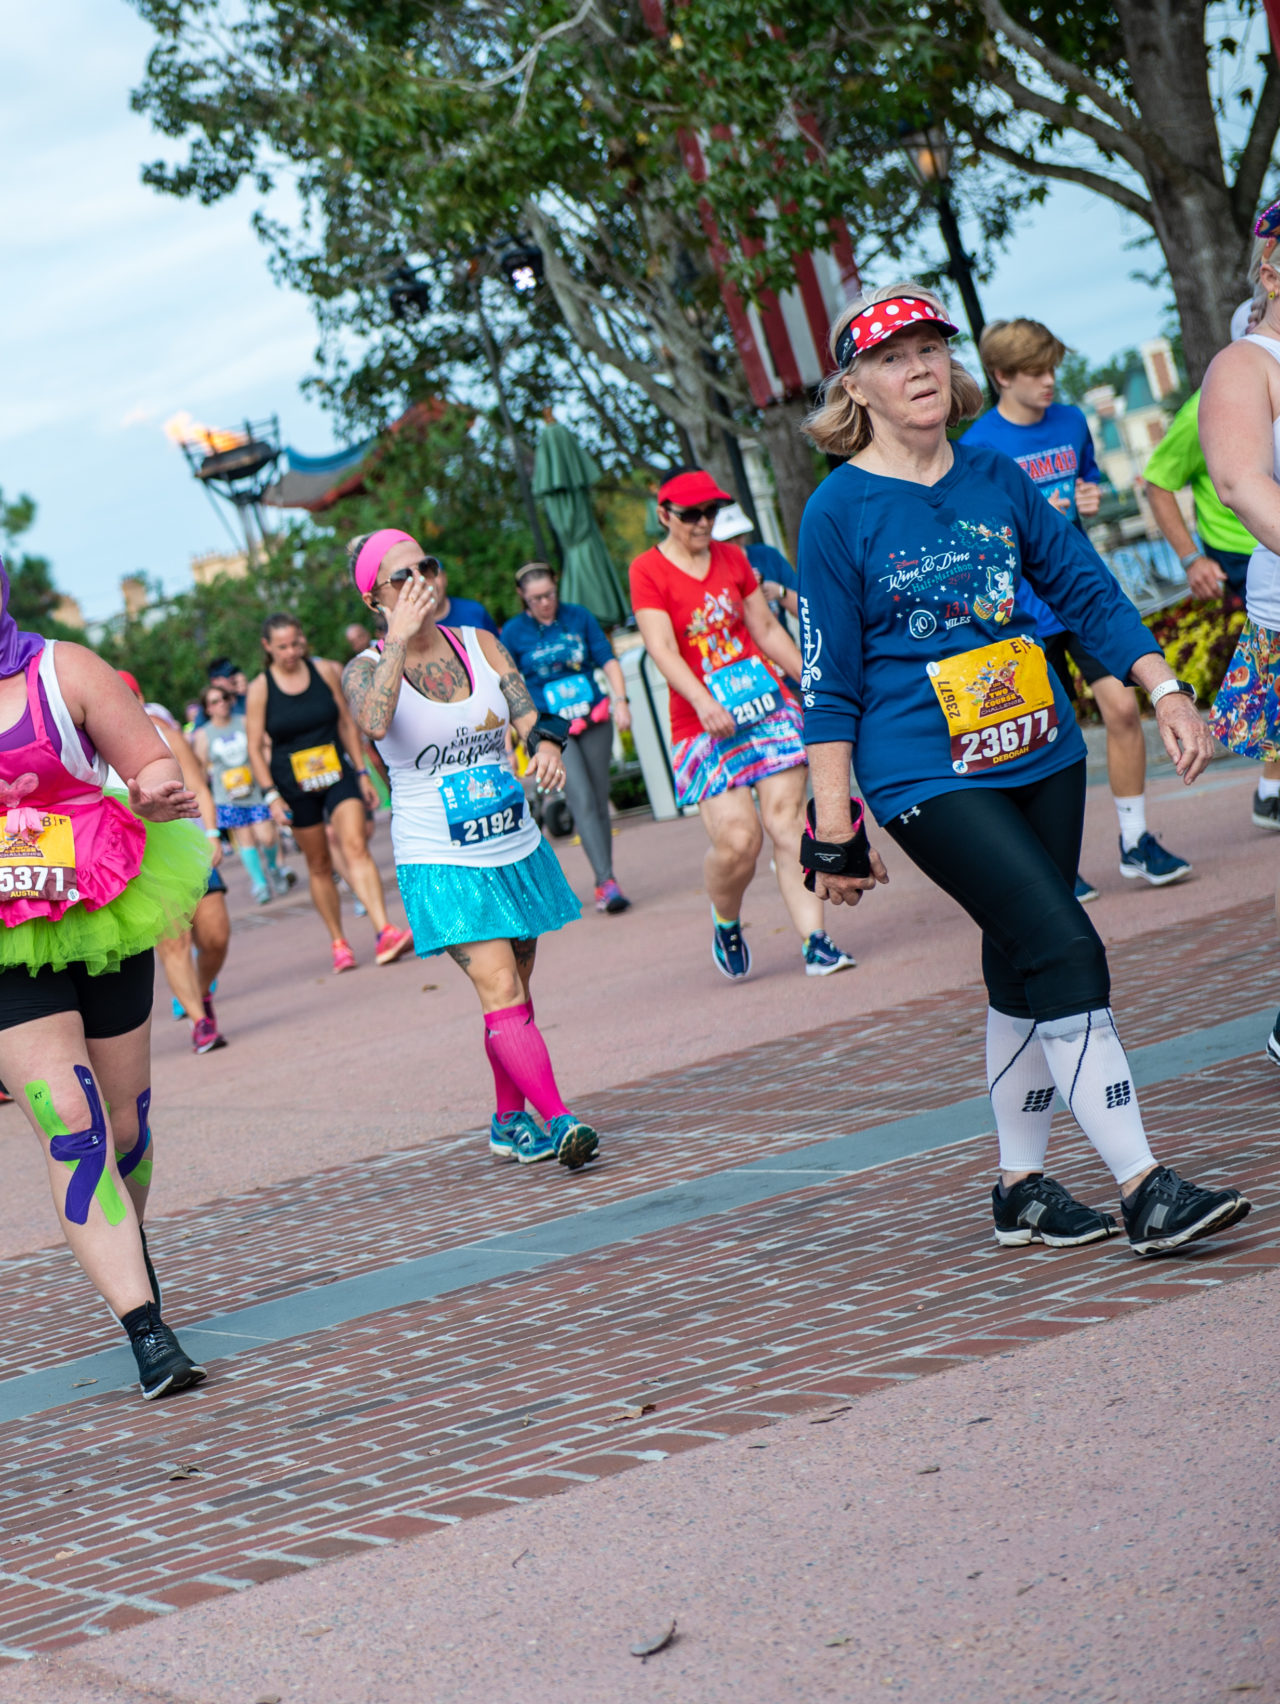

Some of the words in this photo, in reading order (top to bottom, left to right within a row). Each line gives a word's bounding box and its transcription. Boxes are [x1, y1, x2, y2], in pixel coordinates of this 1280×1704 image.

[1055, 449, 1077, 472] 413
[878, 568, 926, 592] Wine
[921, 555, 934, 573] &
[934, 551, 970, 571] Dine
[944, 601, 969, 618] 13.1
[945, 616, 971, 630] MILES
[938, 680, 960, 719] 23677
[732, 692, 776, 725] 2510
[456, 727, 468, 737] I'D
[961, 709, 1048, 763] 23677
[451, 733, 492, 749] RATHER
[992, 746, 1029, 764] DEBORAH
[463, 807, 515, 842] 2192
[10, 890, 39, 898] AUSTIN
[1021, 1102, 1050, 1112] cep
[1106, 1096, 1131, 1109] cep
